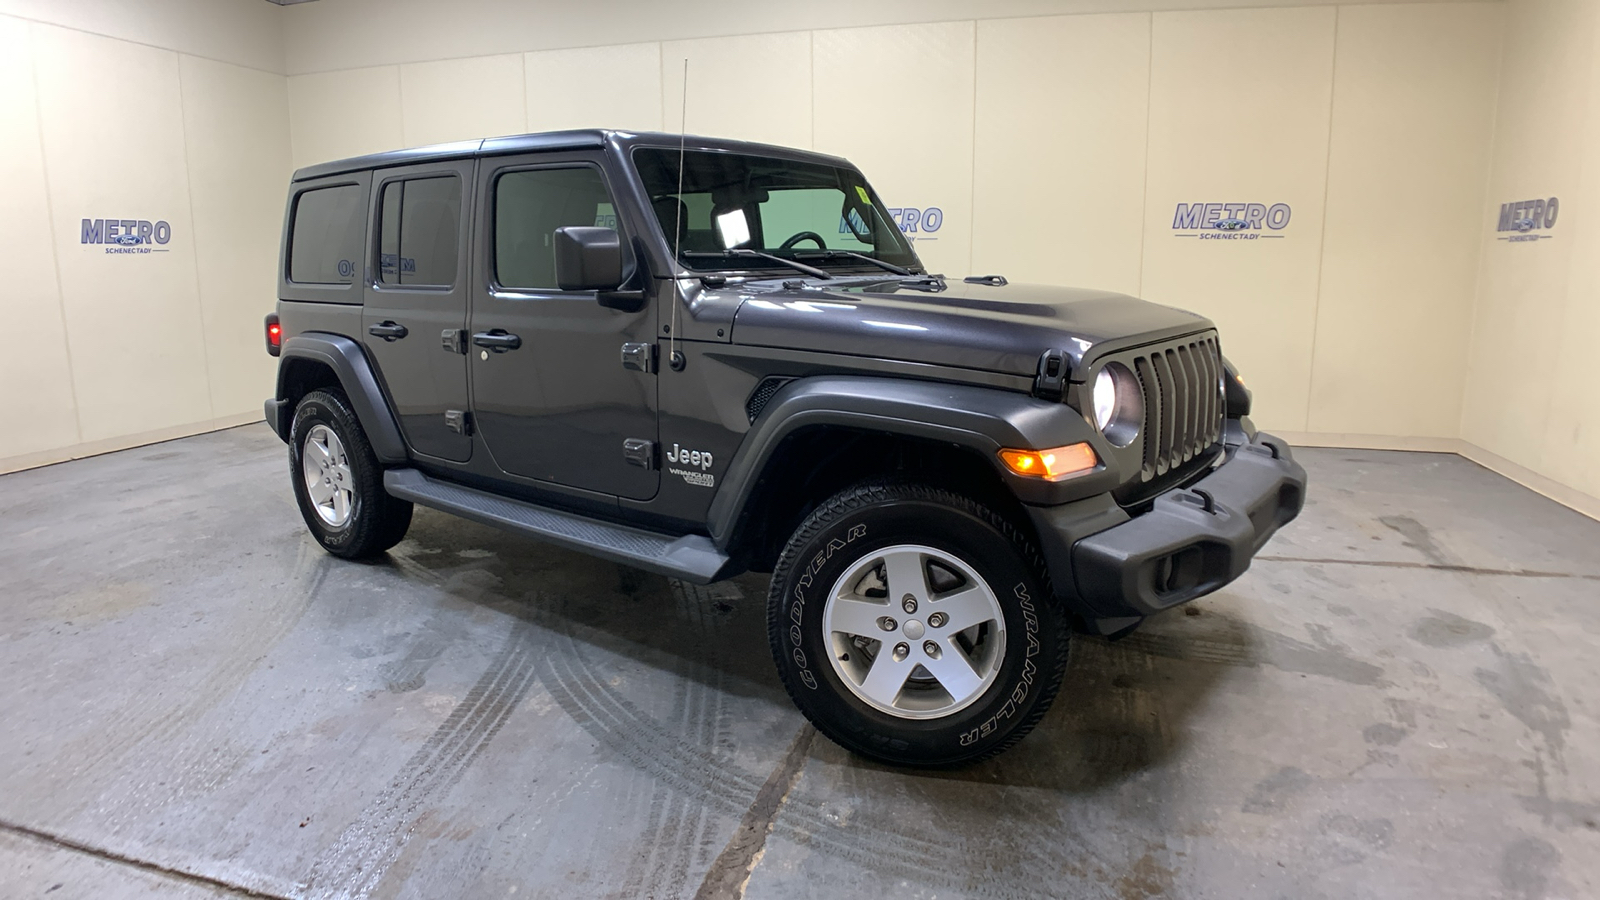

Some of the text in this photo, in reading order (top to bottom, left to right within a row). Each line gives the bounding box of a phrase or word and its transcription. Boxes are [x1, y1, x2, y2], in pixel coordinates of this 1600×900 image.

[1172, 203, 1291, 230] METRO
[1497, 197, 1559, 232] METRO
[81, 219, 171, 245] METRO
[666, 443, 713, 471] Jeep
[668, 467, 714, 480] WRANGLER
[789, 523, 867, 691] GOODYEAR
[959, 582, 1040, 747] WRANGLER
